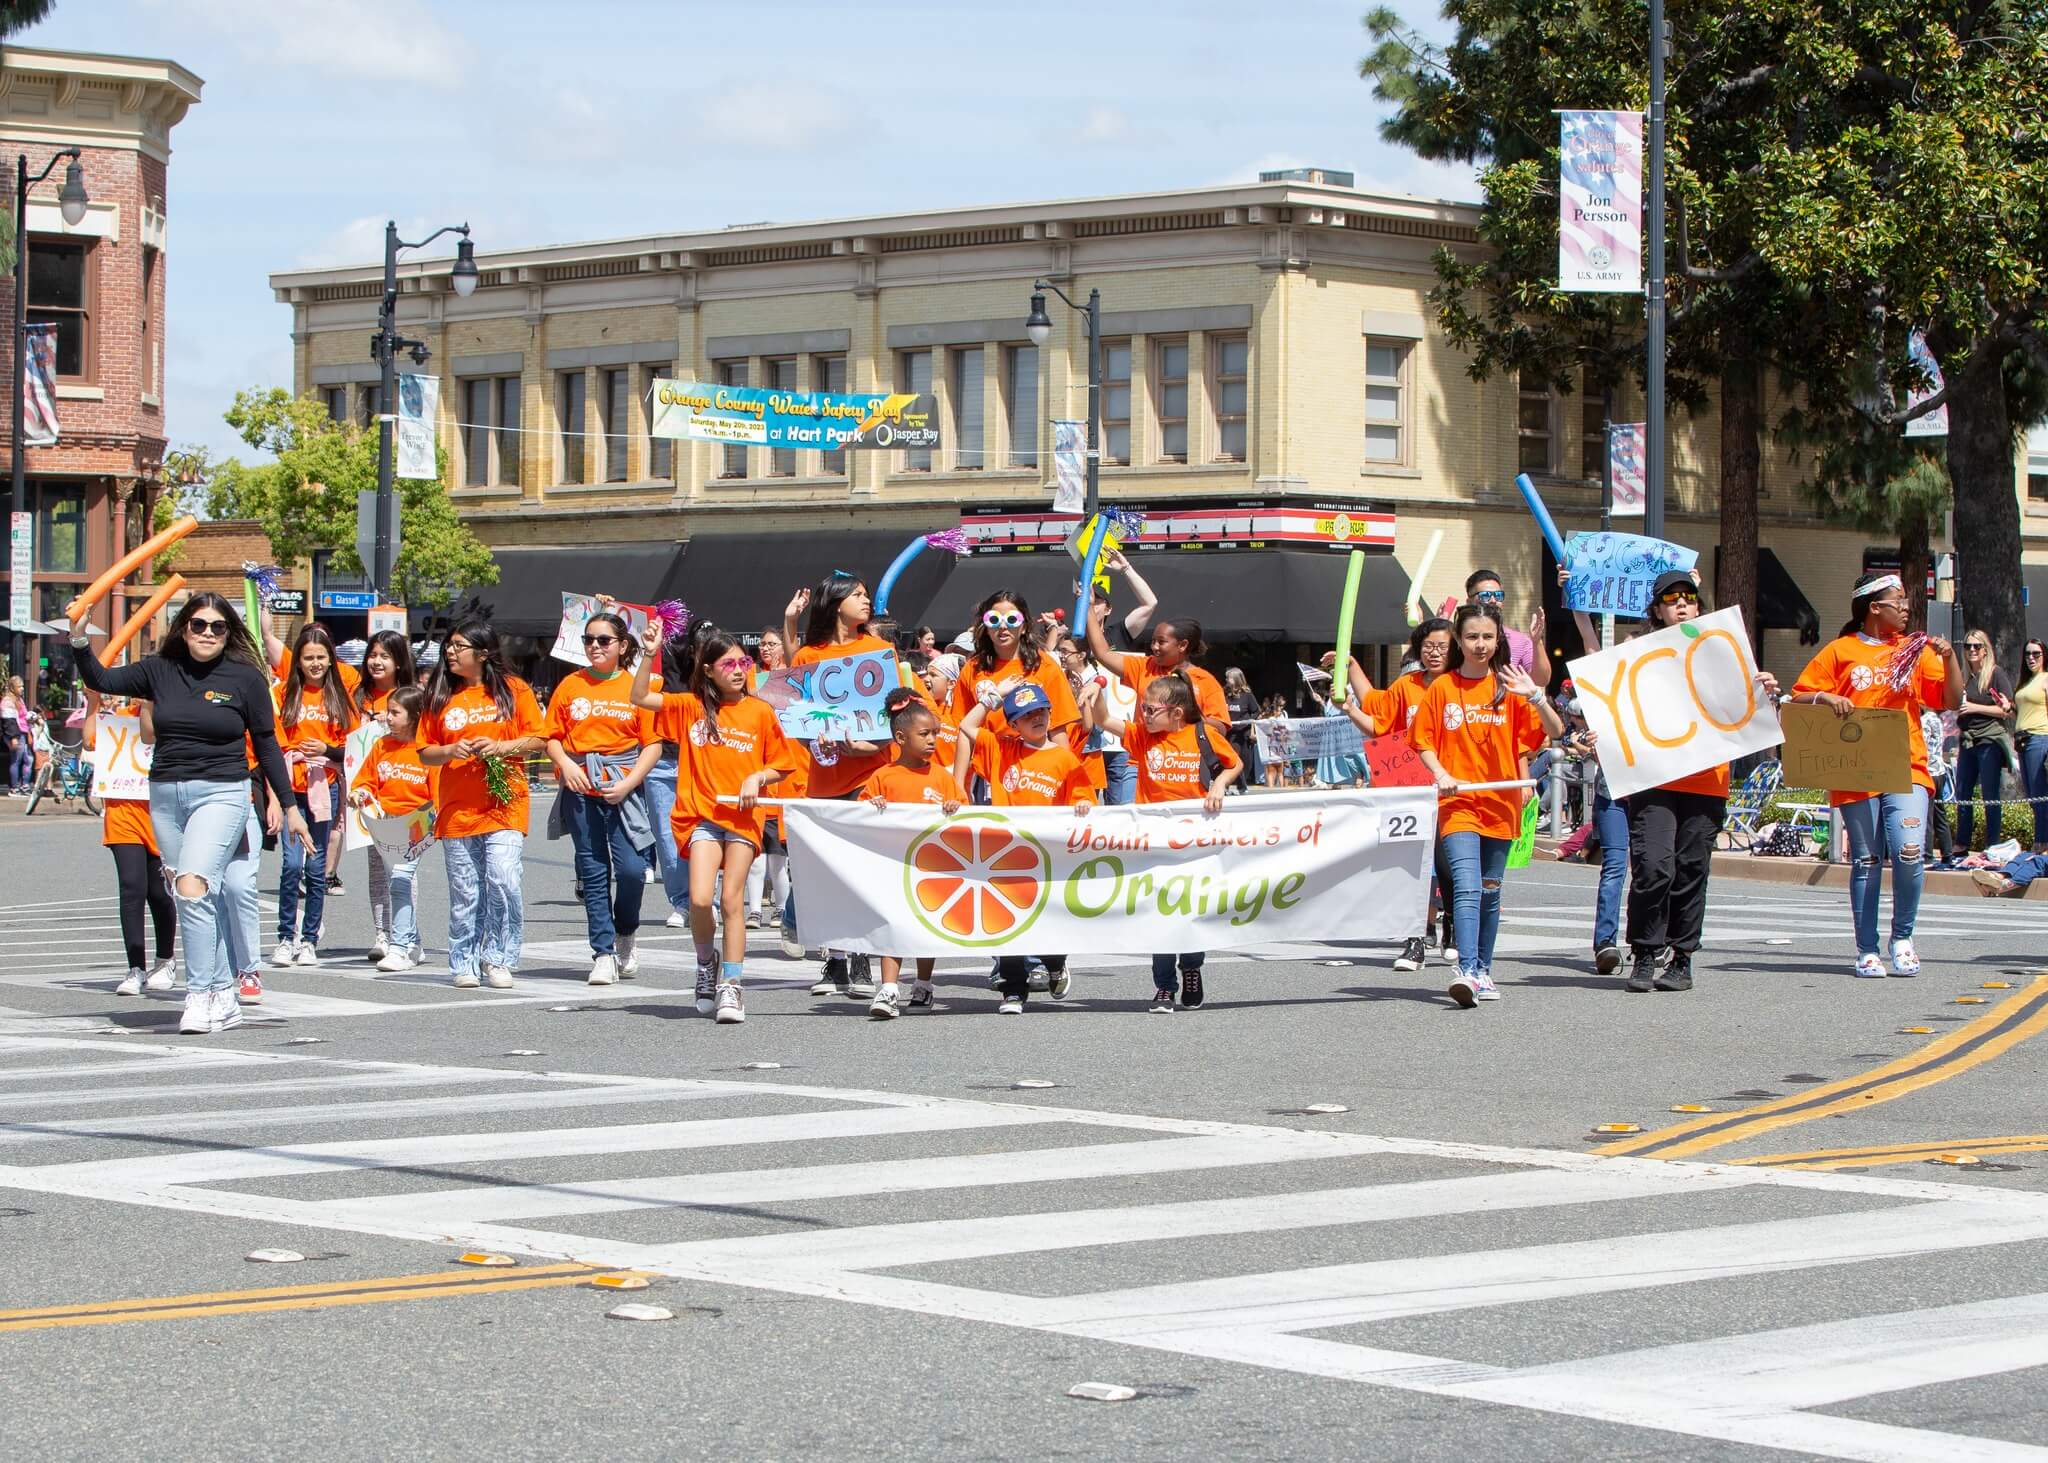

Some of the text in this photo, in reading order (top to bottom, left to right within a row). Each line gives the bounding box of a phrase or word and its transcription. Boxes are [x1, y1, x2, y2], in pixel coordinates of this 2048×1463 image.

[1569, 136, 1632, 156] Orange
[1577, 161, 1625, 173] salutes
[1586, 194, 1611, 207] Jon
[1574, 208, 1628, 222] Persson
[1577, 271, 1623, 280] U.S. ARMY
[659, 387, 711, 415] Orange
[715, 390, 765, 420] County
[822, 397, 865, 424] Safety
[867, 398, 901, 425] Day
[719, 419, 732, 429] May
[770, 425, 864, 442] at Hart Park
[892, 428, 939, 442] Jasper Ray
[1314, 503, 1352, 511] INTERNATIONAL
[1325, 520, 1365, 537] PA KUA
[275, 600, 299, 610] CAFE
[785, 659, 885, 705] YCO
[1575, 628, 1758, 768] YCO
[306, 710, 329, 722] Ora
[592, 705, 633, 722] Orange
[1799, 715, 1863, 745] YCO
[1163, 757, 1200, 772] Orange
[391, 769, 427, 785] Orange
[1167, 773, 1187, 782] CAMP
[1018, 776, 1057, 798] Orange
[1297, 811, 1323, 847] of
[1388, 814, 1418, 837] 22
[1063, 855, 1306, 927] Orange
